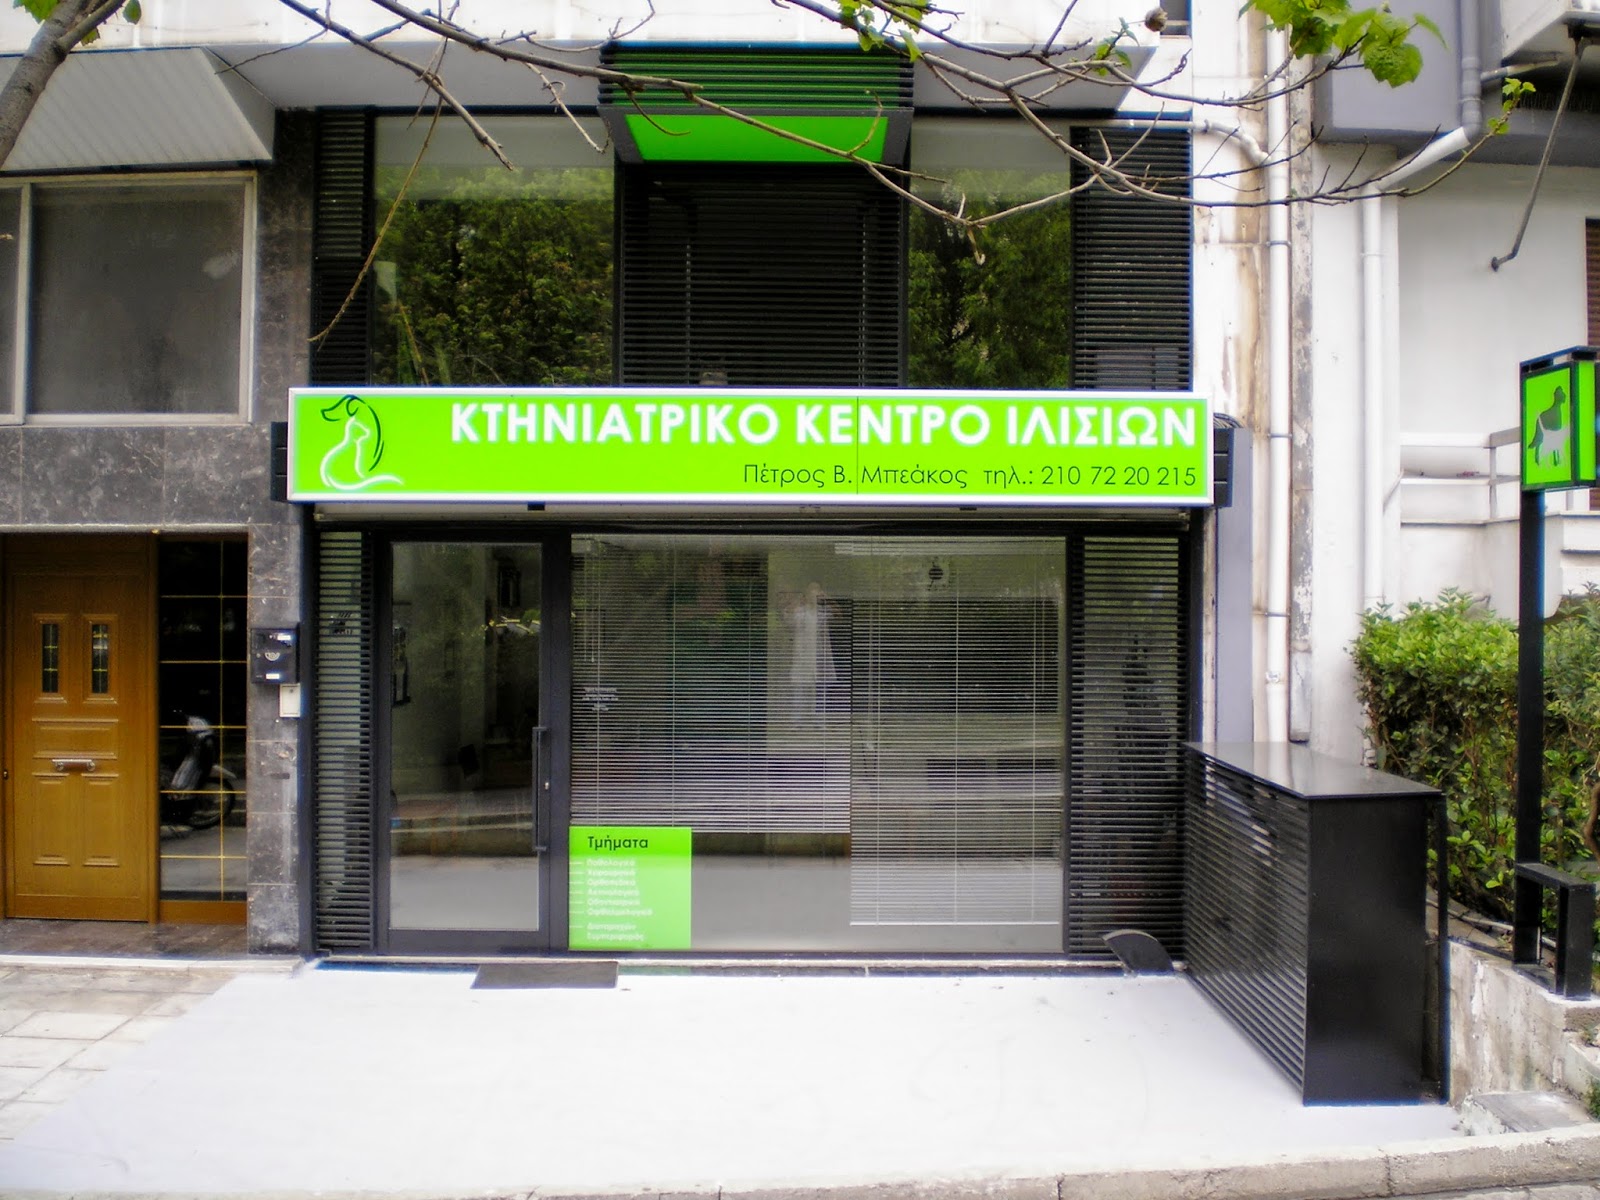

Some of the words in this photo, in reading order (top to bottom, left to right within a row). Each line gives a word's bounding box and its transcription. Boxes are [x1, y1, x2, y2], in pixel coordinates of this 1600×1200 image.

[450, 402, 780, 446] ΚΤΗΝΙΑΤΡΙΚΟ
[796, 403, 991, 446] ΚΕΝΤΡΟ
[1007, 405, 1196, 447] ΙΛΙΣΙΩΝ
[743, 463, 825, 488] Πέτρος
[833, 464, 853, 484] Β.
[861, 463, 968, 489] Μπεάκος
[983, 466, 1034, 489] τηλ.:
[1040, 465, 1081, 485] 210
[1090, 466, 1116, 485] 72
[1123, 466, 1150, 486] 20
[1156, 467, 1197, 486] 215
[587, 835, 649, 851] Τμήματα
